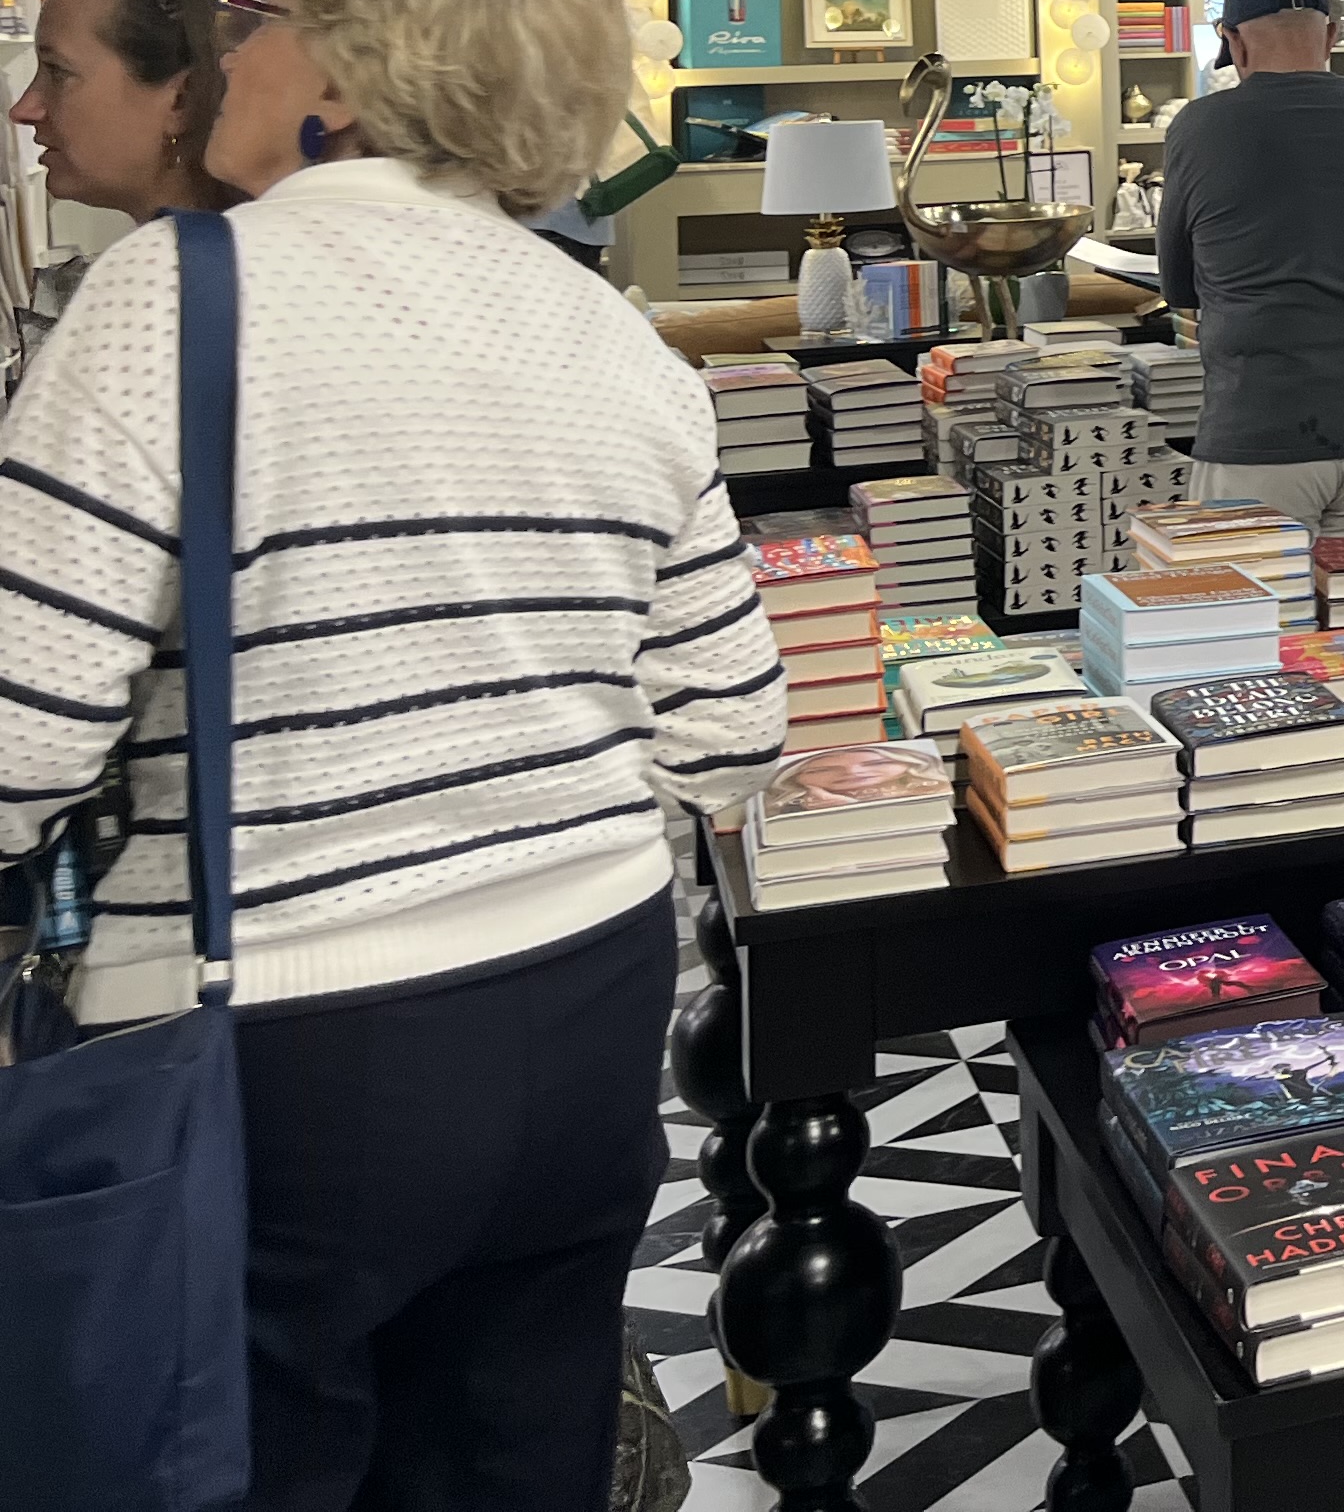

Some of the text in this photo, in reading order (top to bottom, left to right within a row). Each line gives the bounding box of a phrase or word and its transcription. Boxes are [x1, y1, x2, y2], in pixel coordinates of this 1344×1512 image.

[1223, 677, 1289, 692] THE
[1191, 693, 1319, 719] BELONG
[1203, 687, 1289, 707] DEAD
[1218, 706, 1308, 726] HERE
[1158, 948, 1252, 972] OPAL
